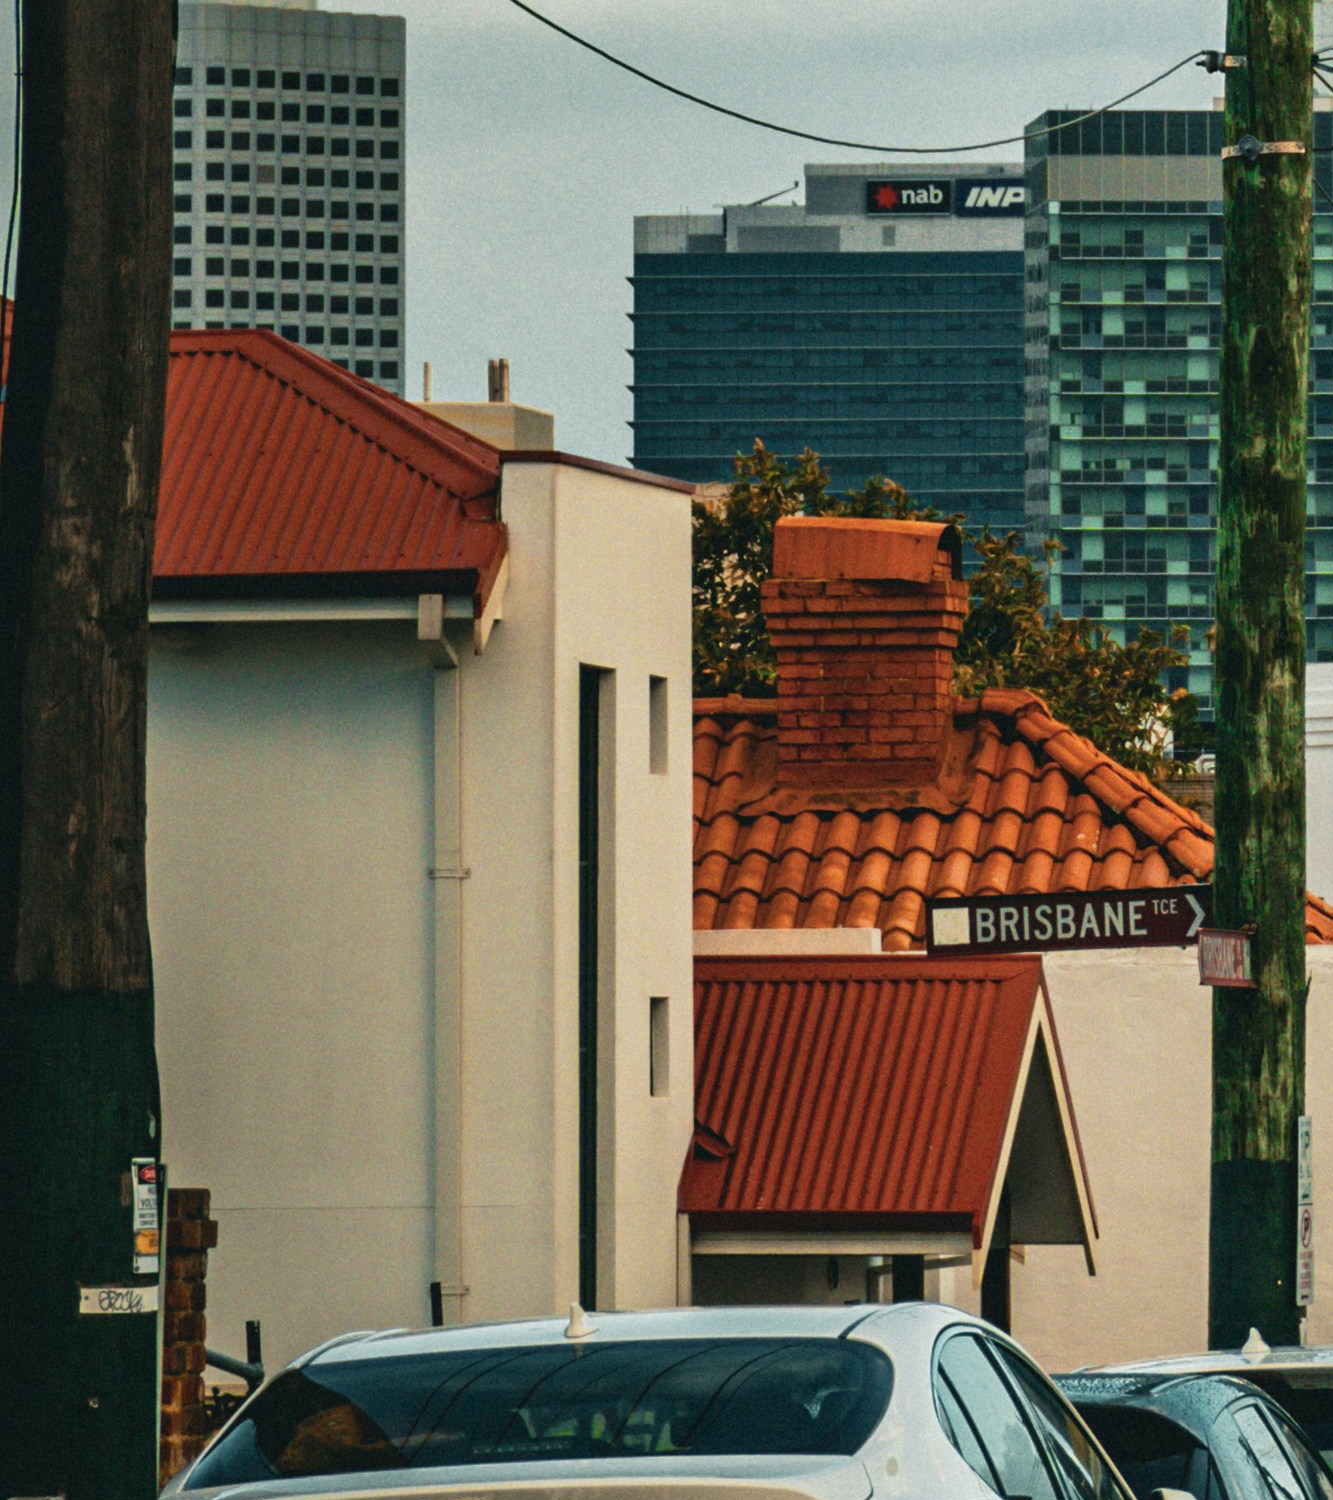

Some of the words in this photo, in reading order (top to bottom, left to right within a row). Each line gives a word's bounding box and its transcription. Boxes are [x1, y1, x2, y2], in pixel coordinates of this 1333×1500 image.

[901, 184, 944, 204] nab
[975, 900, 1148, 943] BRISBANE
[1152, 899, 1179, 915] TCE
